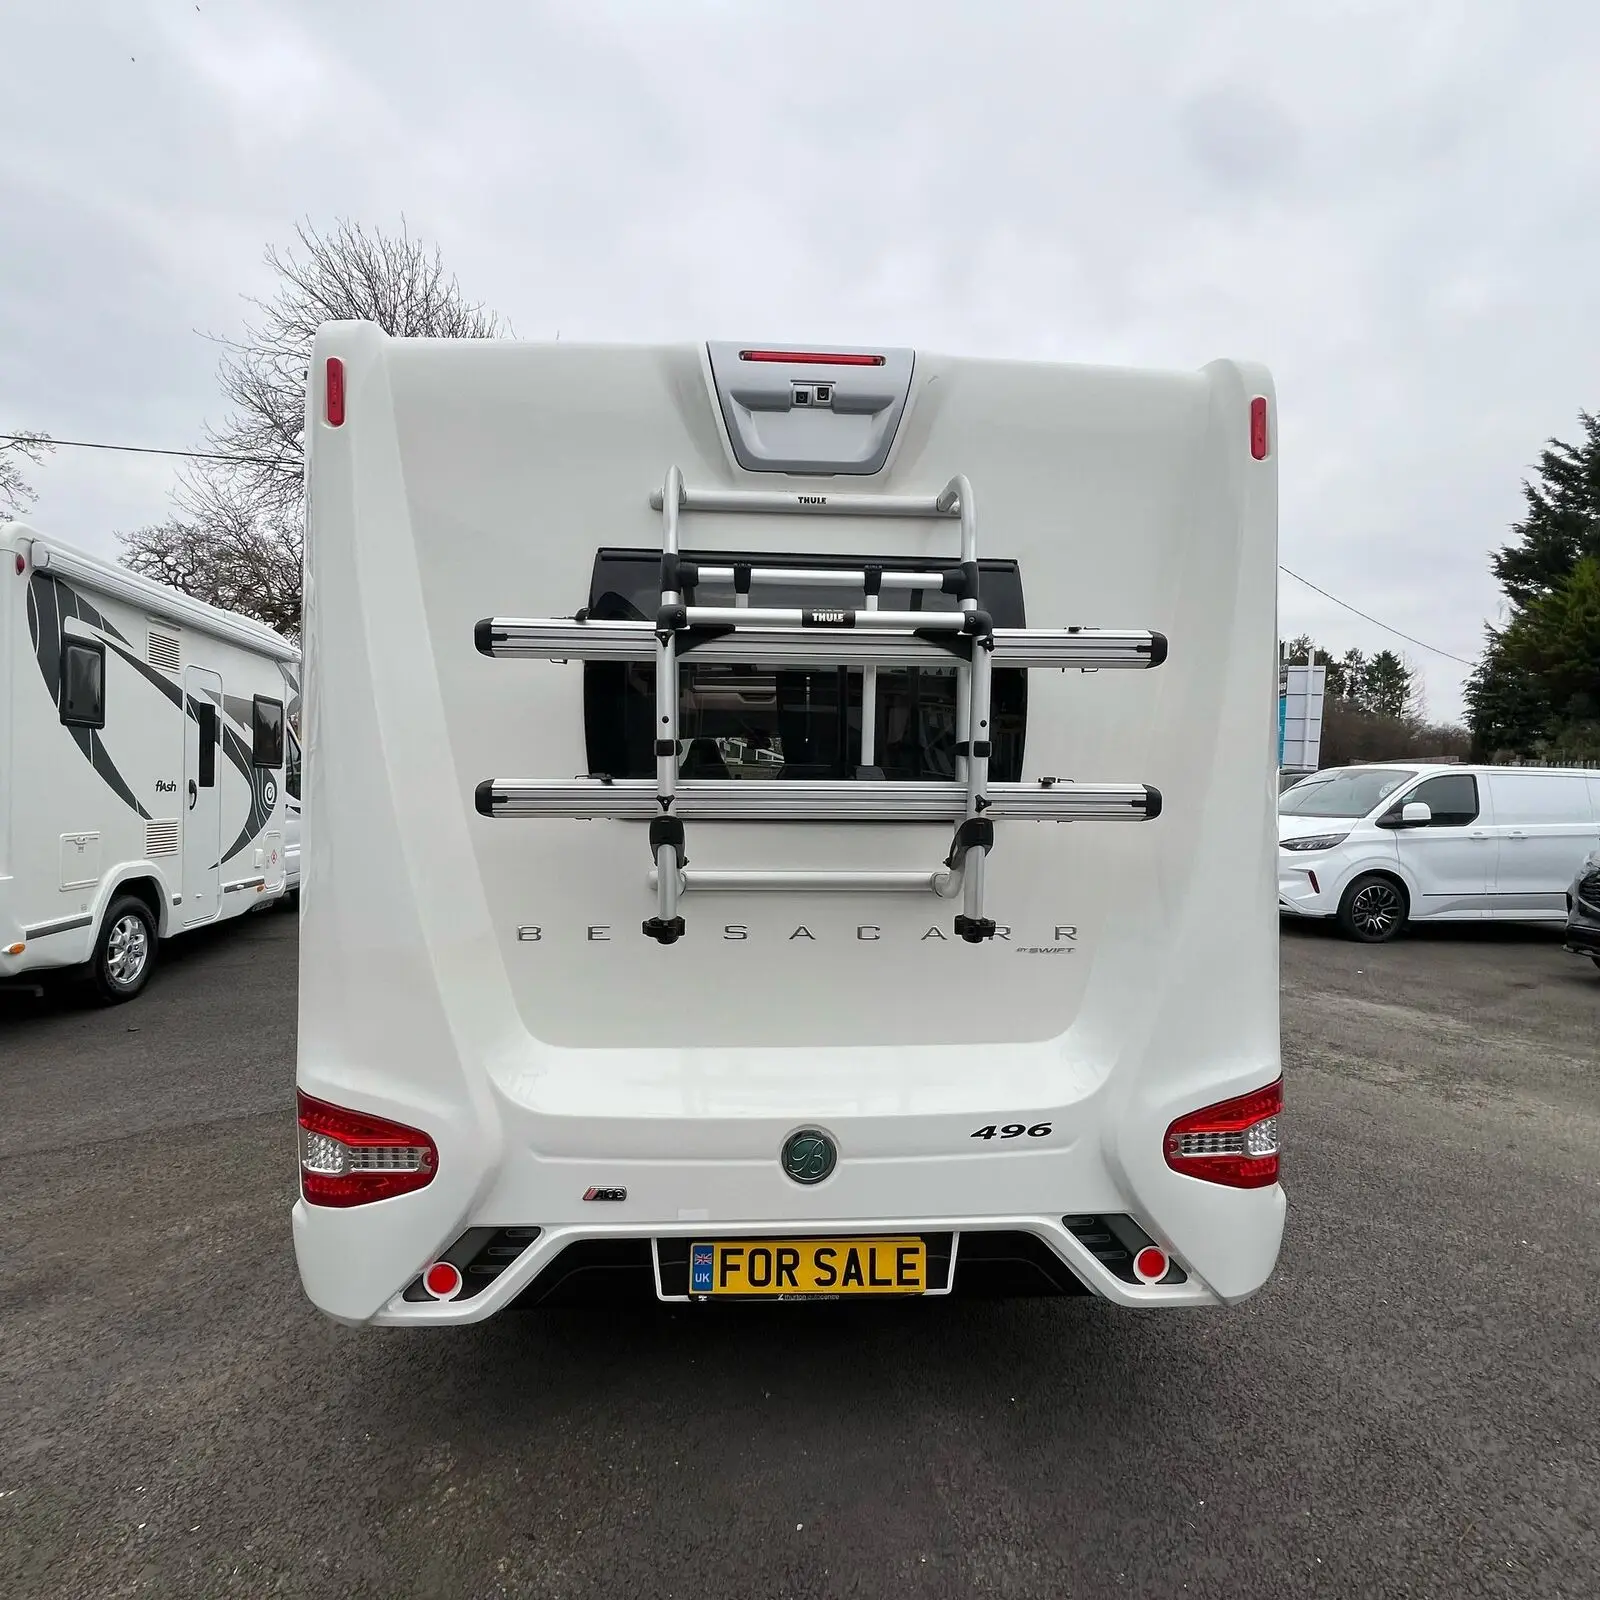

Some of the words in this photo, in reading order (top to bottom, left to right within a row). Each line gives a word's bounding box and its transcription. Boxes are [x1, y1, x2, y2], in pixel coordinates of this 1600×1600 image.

[797, 496, 827, 504] THULE
[811, 612, 844, 622] THULE
[517, 924, 1078, 941] BESACARR
[970, 1122, 1052, 1140] 496
[719, 1247, 800, 1288] FOR
[813, 1246, 920, 1288] SALE
[695, 1272, 710, 1283] UK
